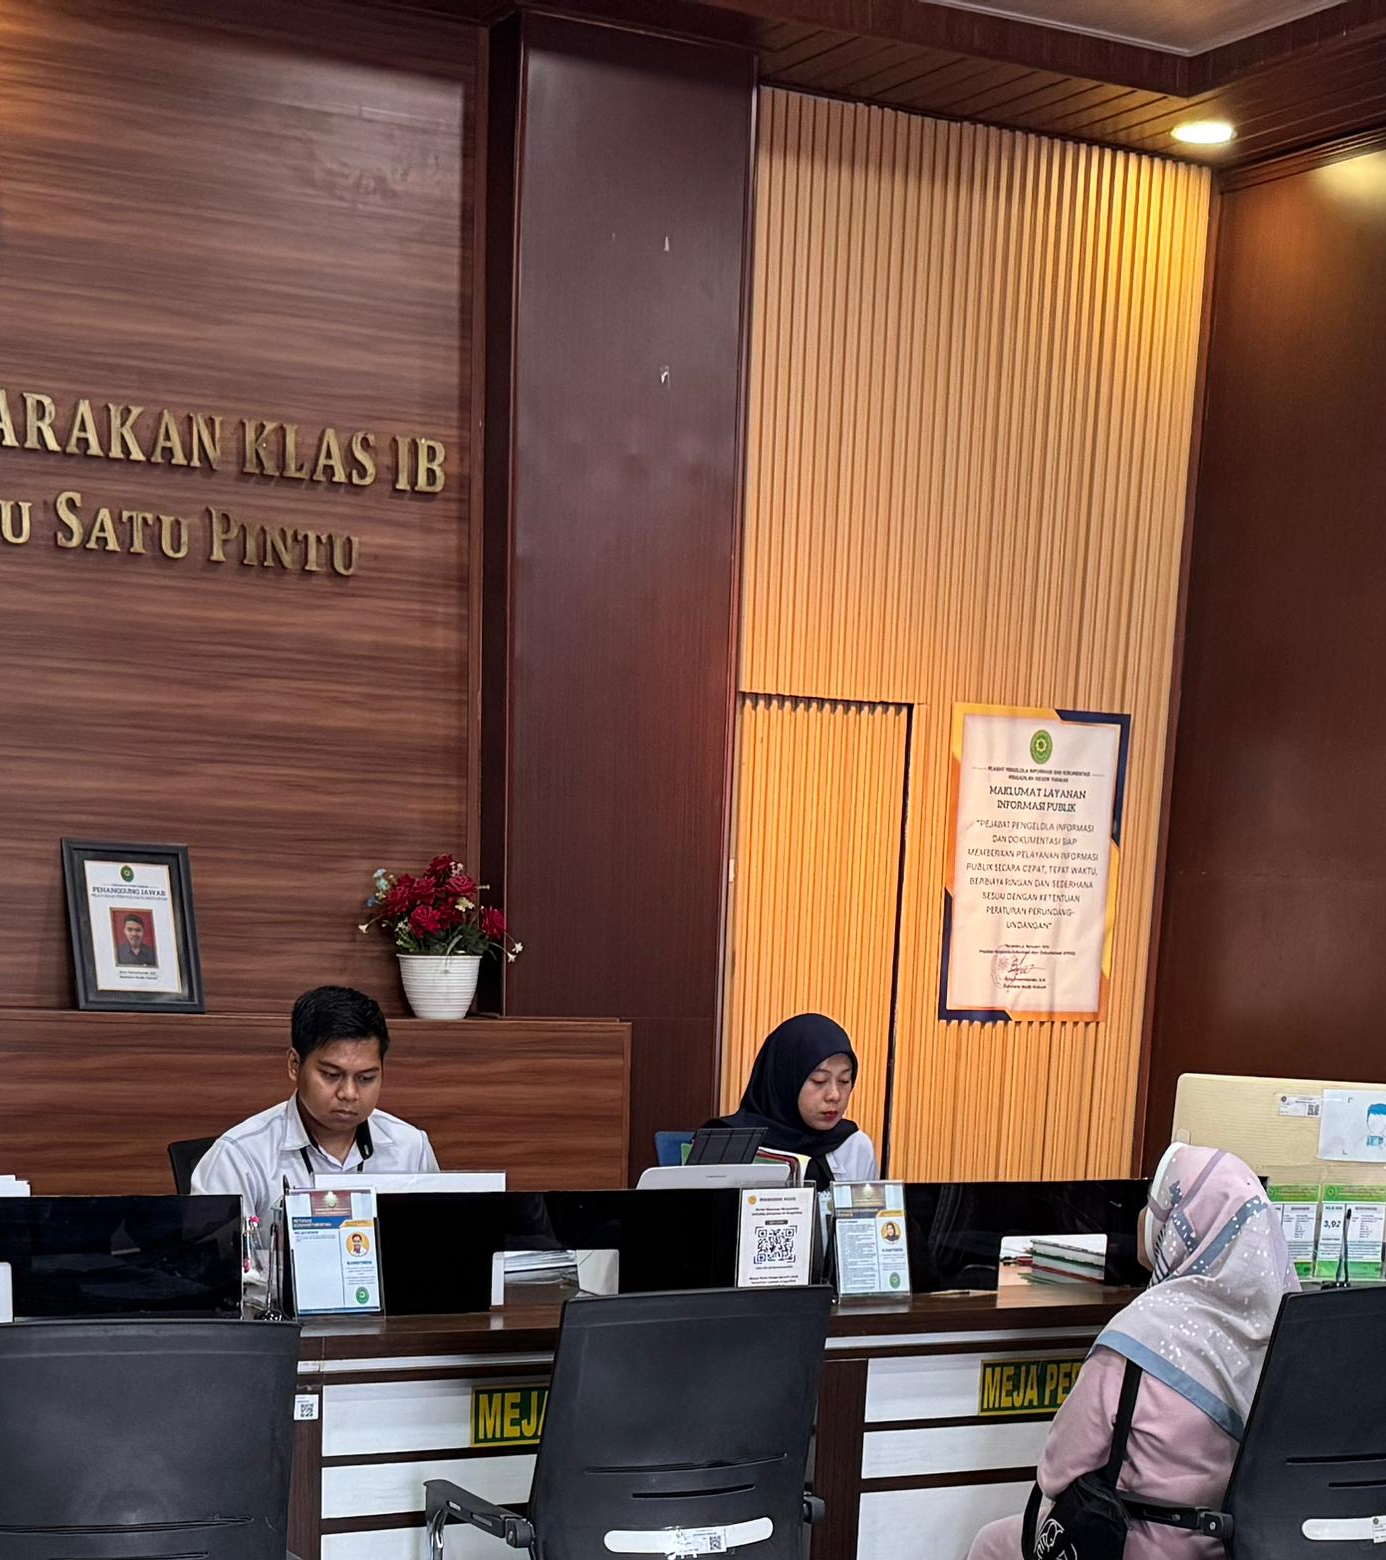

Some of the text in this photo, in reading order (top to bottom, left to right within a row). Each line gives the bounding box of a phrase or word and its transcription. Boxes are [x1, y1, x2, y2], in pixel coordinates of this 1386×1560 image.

[241, 418, 375, 487] KLAS
[393, 436, 446, 494] IB
[55, 490, 190, 559] SATU
[207, 505, 360, 576] PINTU
[989, 785, 1086, 799] MAKLUMAT LAYANAN
[997, 800, 1076, 813] INFORMASI PUBLIK
[983, 1364, 1039, 1409] MEJA
[479, 1390, 549, 1439] MEJ
